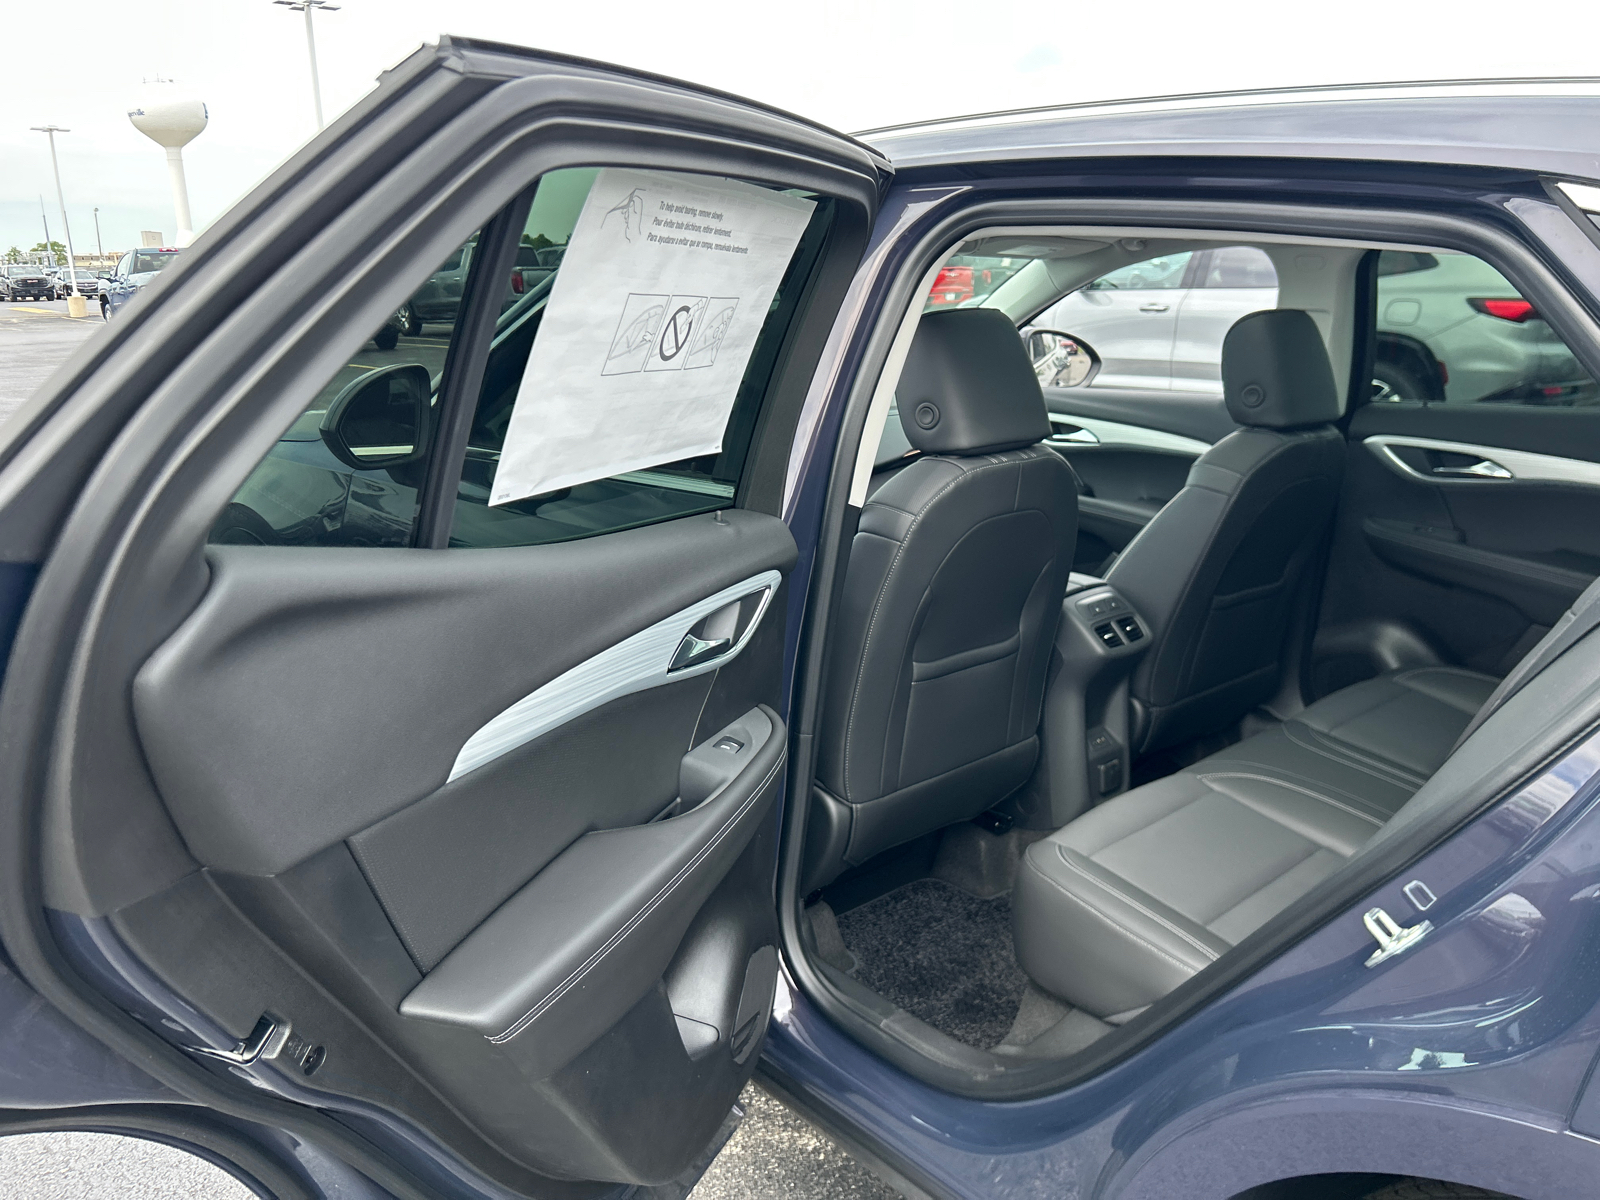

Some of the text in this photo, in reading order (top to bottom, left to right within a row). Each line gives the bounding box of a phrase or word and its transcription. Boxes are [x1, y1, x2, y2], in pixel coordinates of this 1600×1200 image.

[659, 200, 665, 210] To
[665, 202, 674, 213] help
[674, 204, 685, 213] avoid
[698, 209, 711, 218] remove
[652, 216, 663, 226] Pour
[647, 231, 658, 242] Para
[696, 240, 701, 248] se
